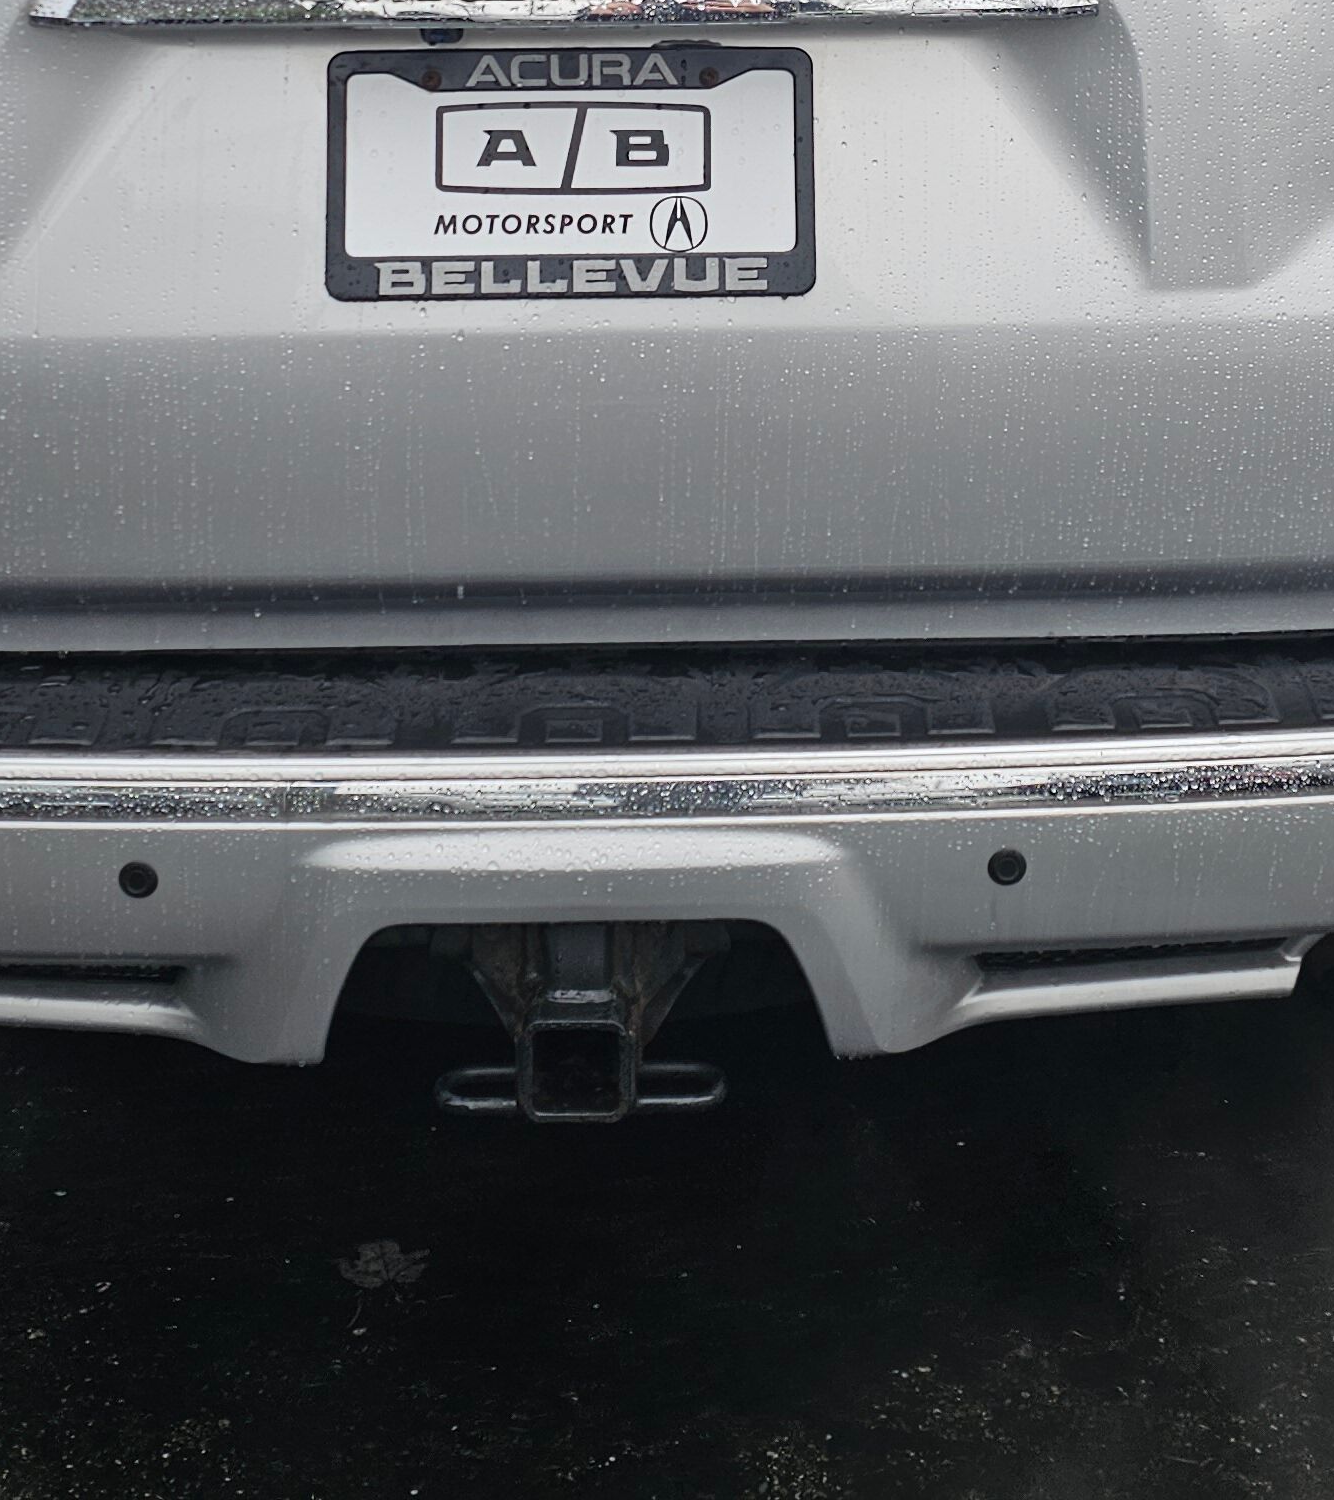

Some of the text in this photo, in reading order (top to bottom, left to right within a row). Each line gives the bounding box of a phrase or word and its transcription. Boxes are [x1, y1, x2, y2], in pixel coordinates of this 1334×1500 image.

[465, 53, 679, 87] ACURA
[476, 129, 669, 167] A B
[433, 213, 634, 235] MOTORSPORT
[373, 257, 769, 297] BELLEVUE
